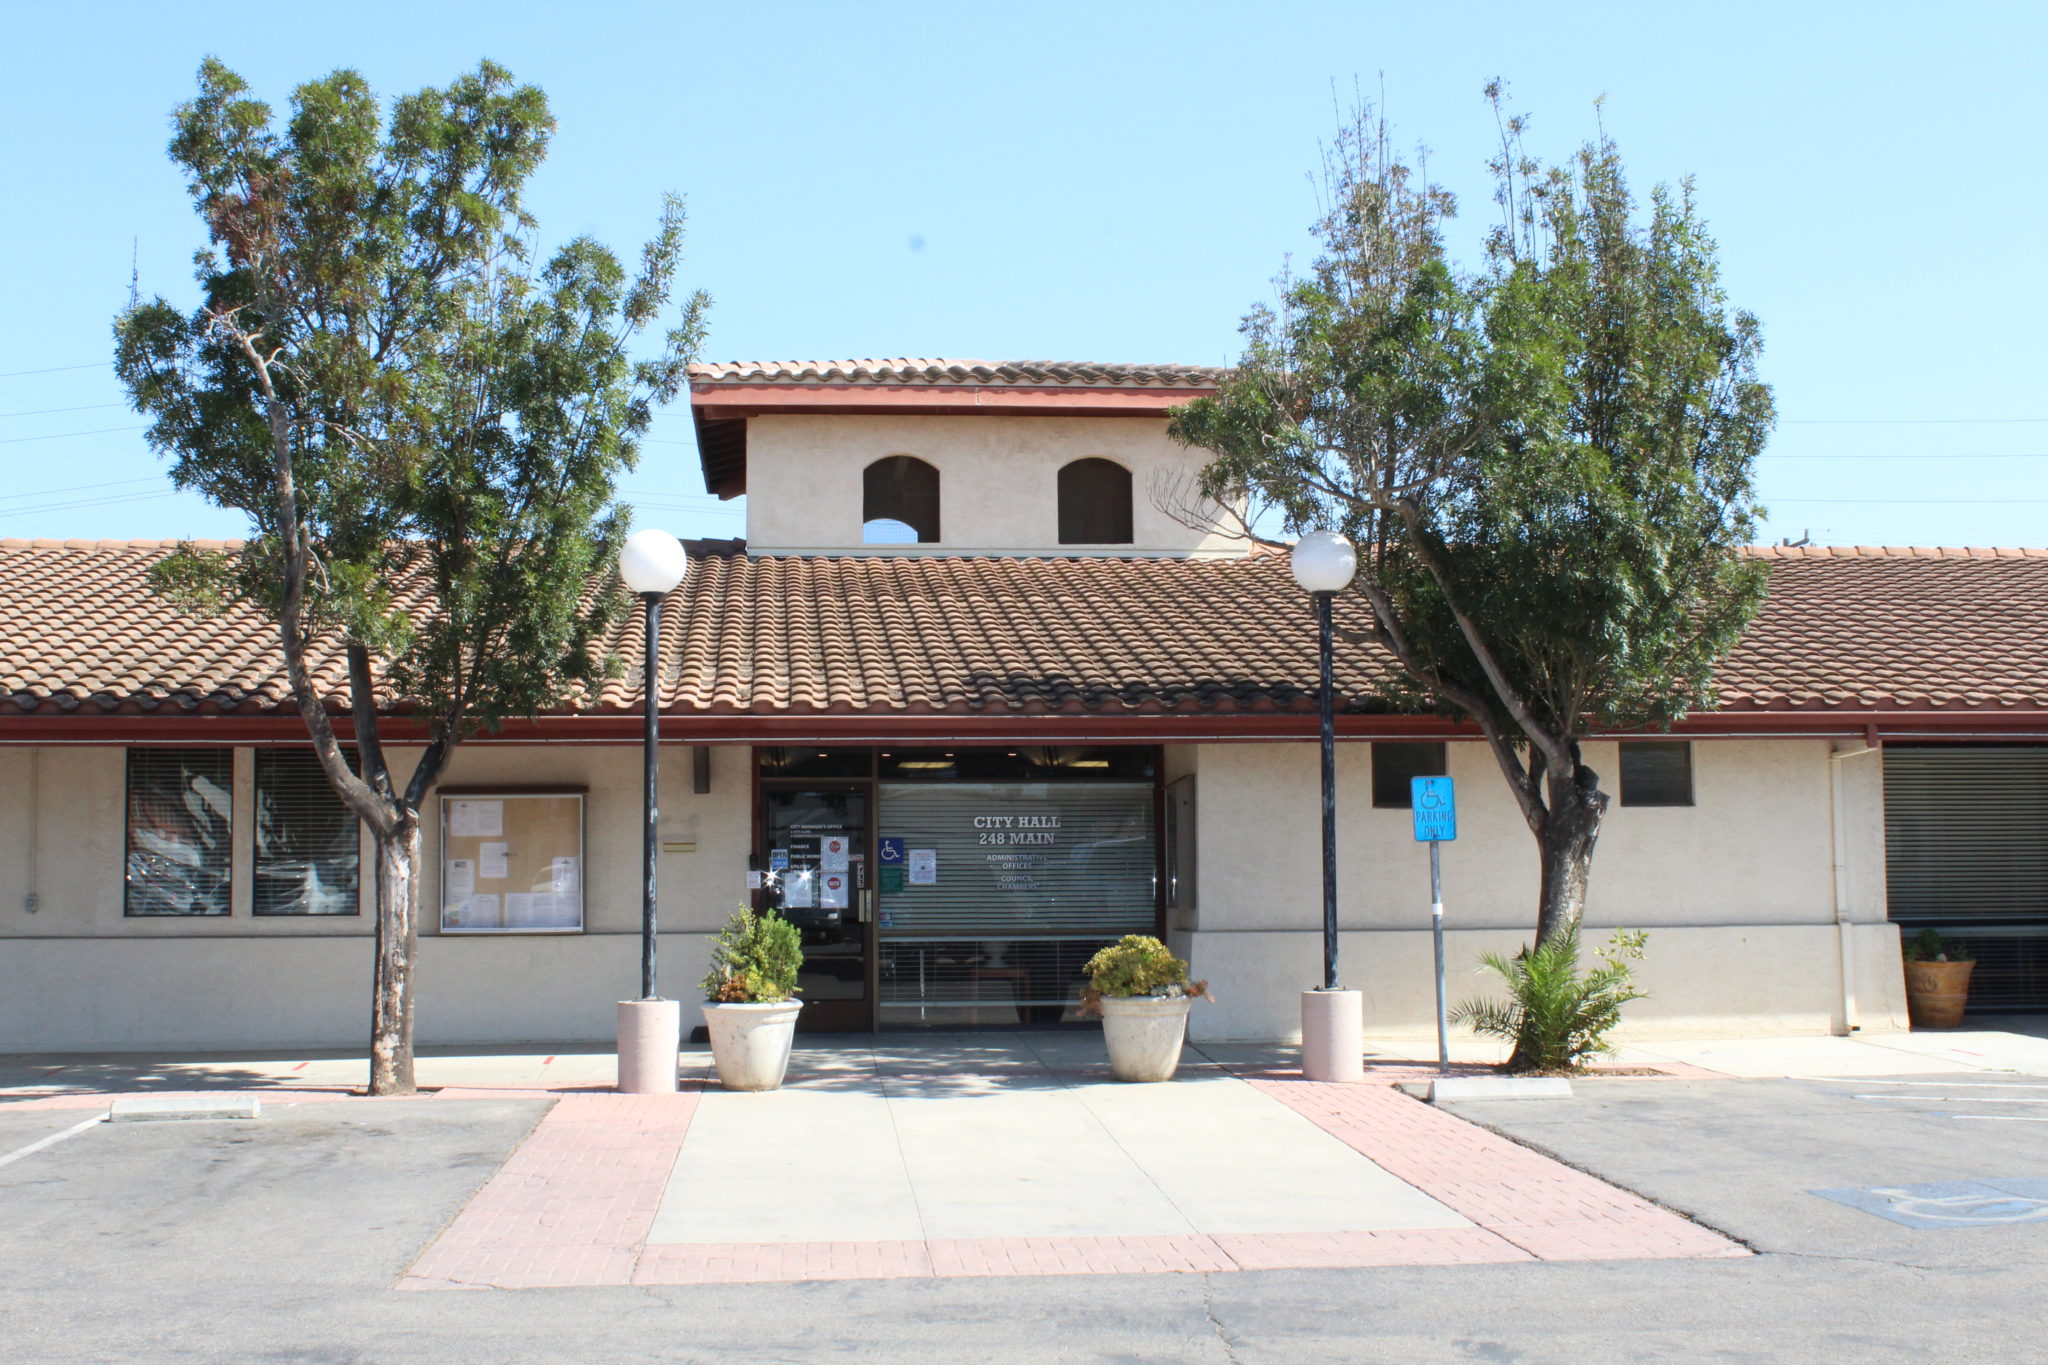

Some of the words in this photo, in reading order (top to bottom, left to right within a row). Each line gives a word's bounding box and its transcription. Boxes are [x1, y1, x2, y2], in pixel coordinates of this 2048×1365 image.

[974, 816, 1015, 828] CITY
[1018, 816, 1061, 828] HALL
[1416, 810, 1452, 823] PARKING
[1424, 825, 1444, 837] ONLY
[979, 833, 1005, 845] 248
[1009, 833, 1056, 845] MAIN
[986, 854, 1048, 862] ADMINISTRATIVE
[1002, 862, 1033, 870] OFFICES
